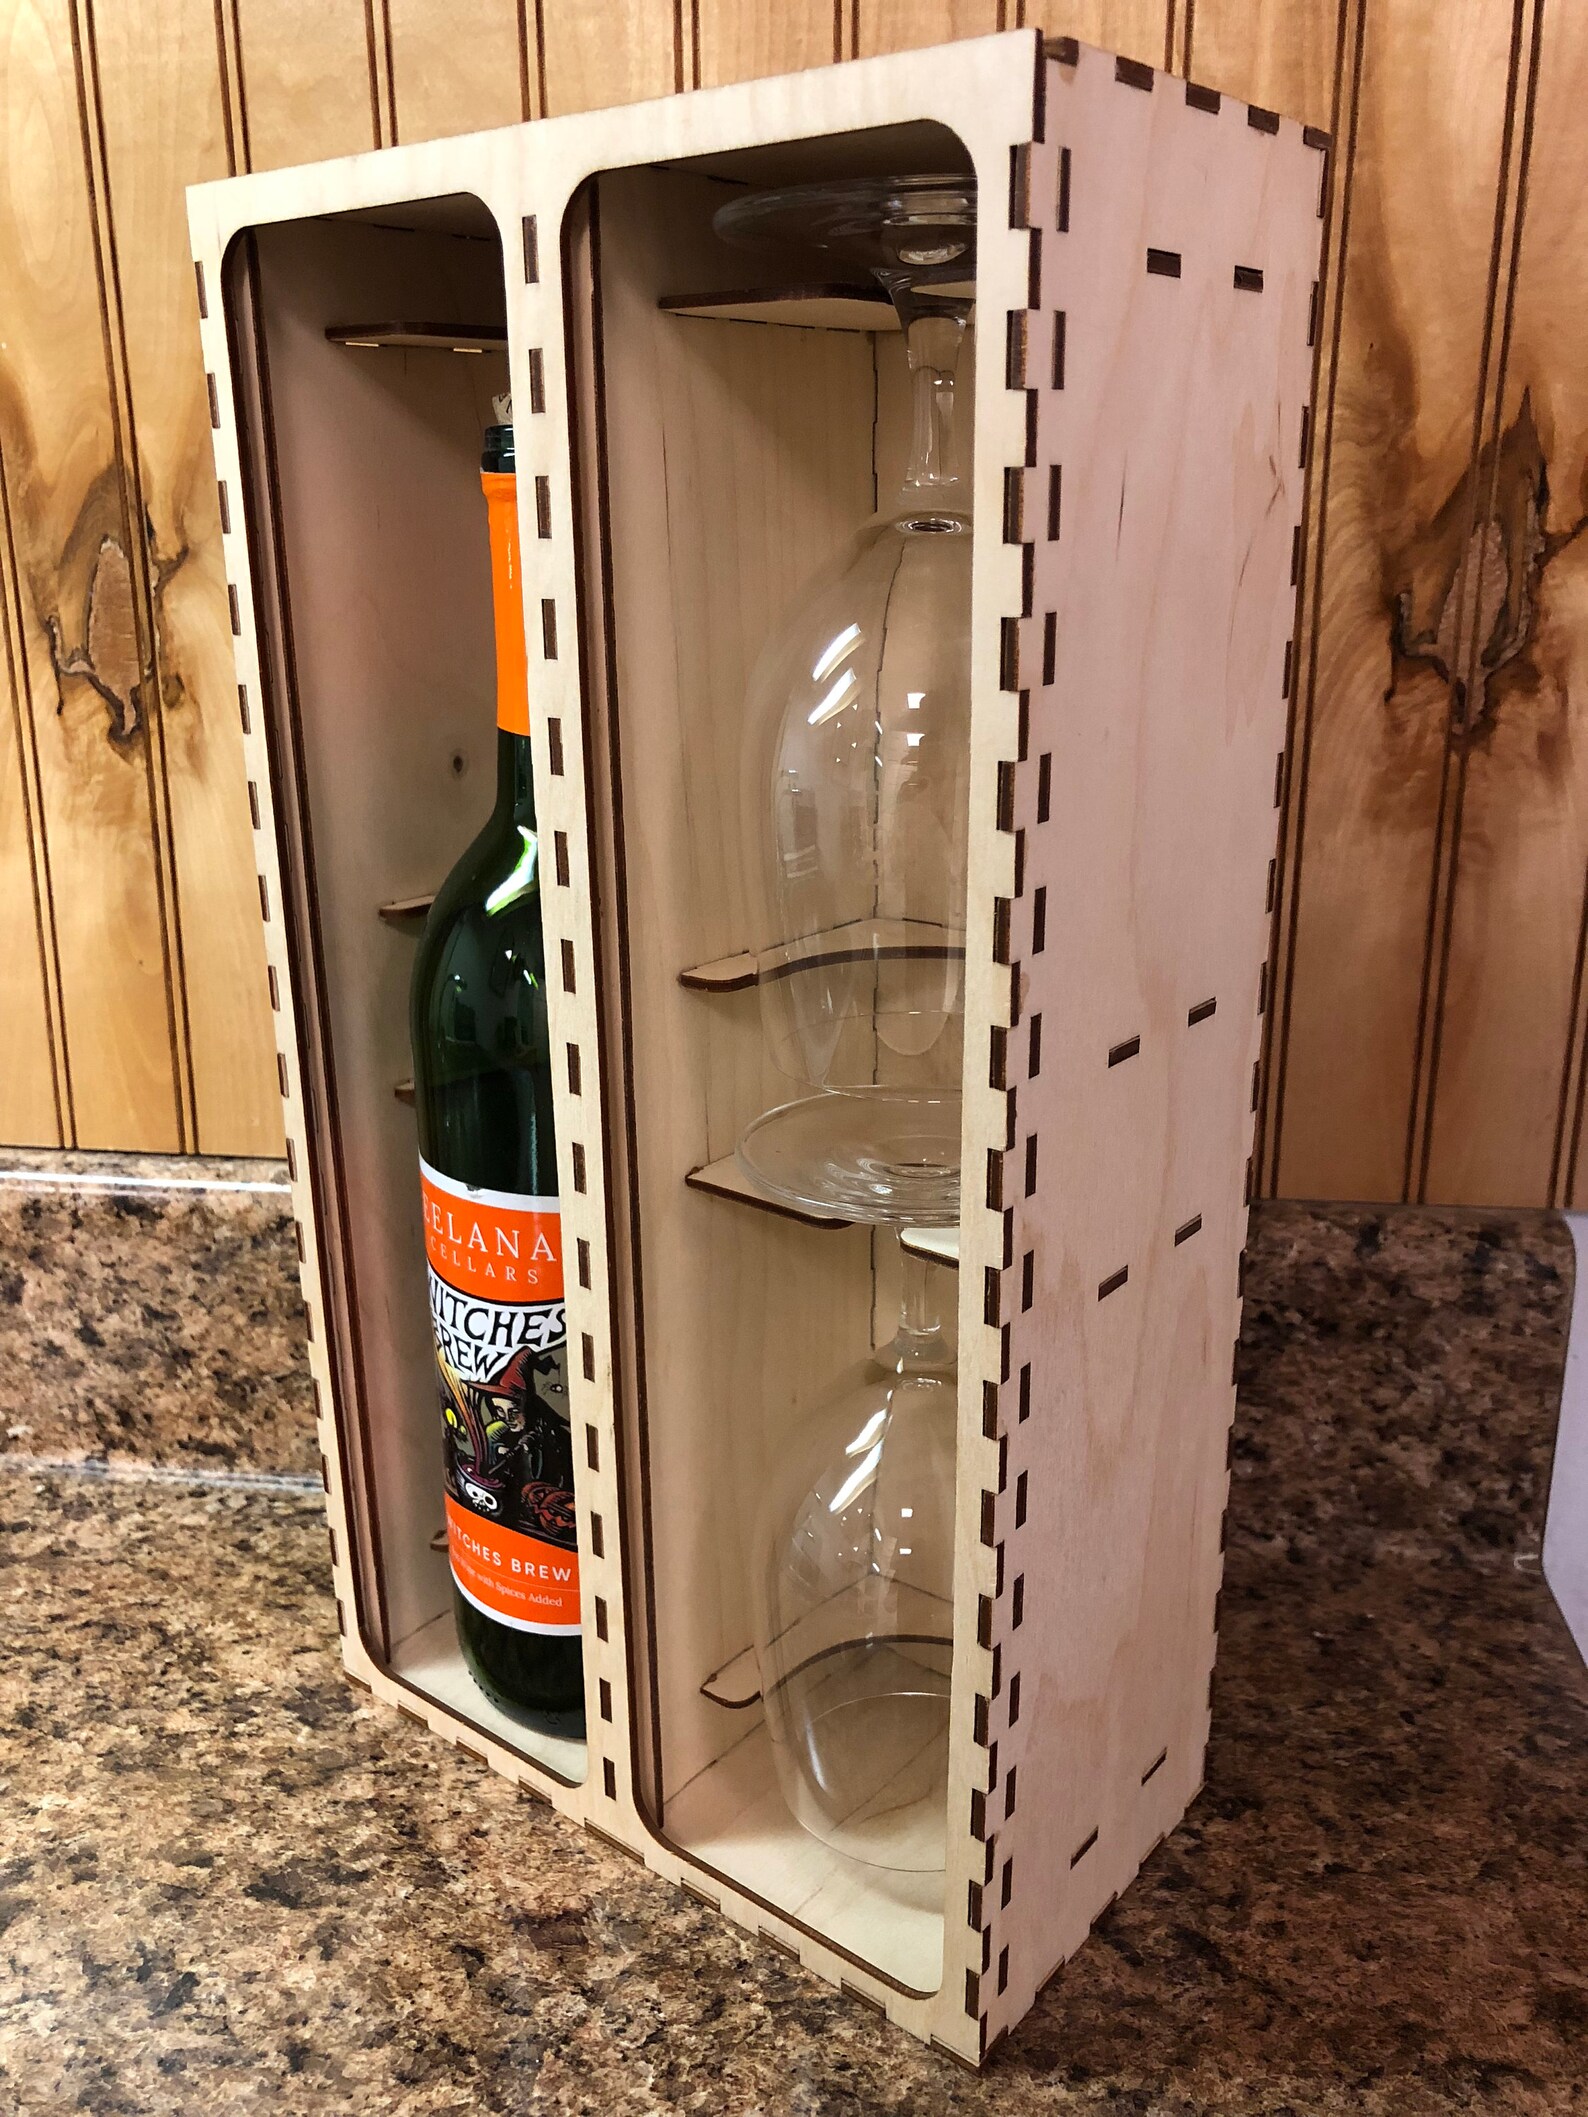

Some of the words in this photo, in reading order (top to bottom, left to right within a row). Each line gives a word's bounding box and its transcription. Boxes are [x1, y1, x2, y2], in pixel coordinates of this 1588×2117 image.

[430, 1235, 539, 1285] CELLARS
[511, 1557, 572, 1582] BREW
[528, 1592, 563, 1608] Added
